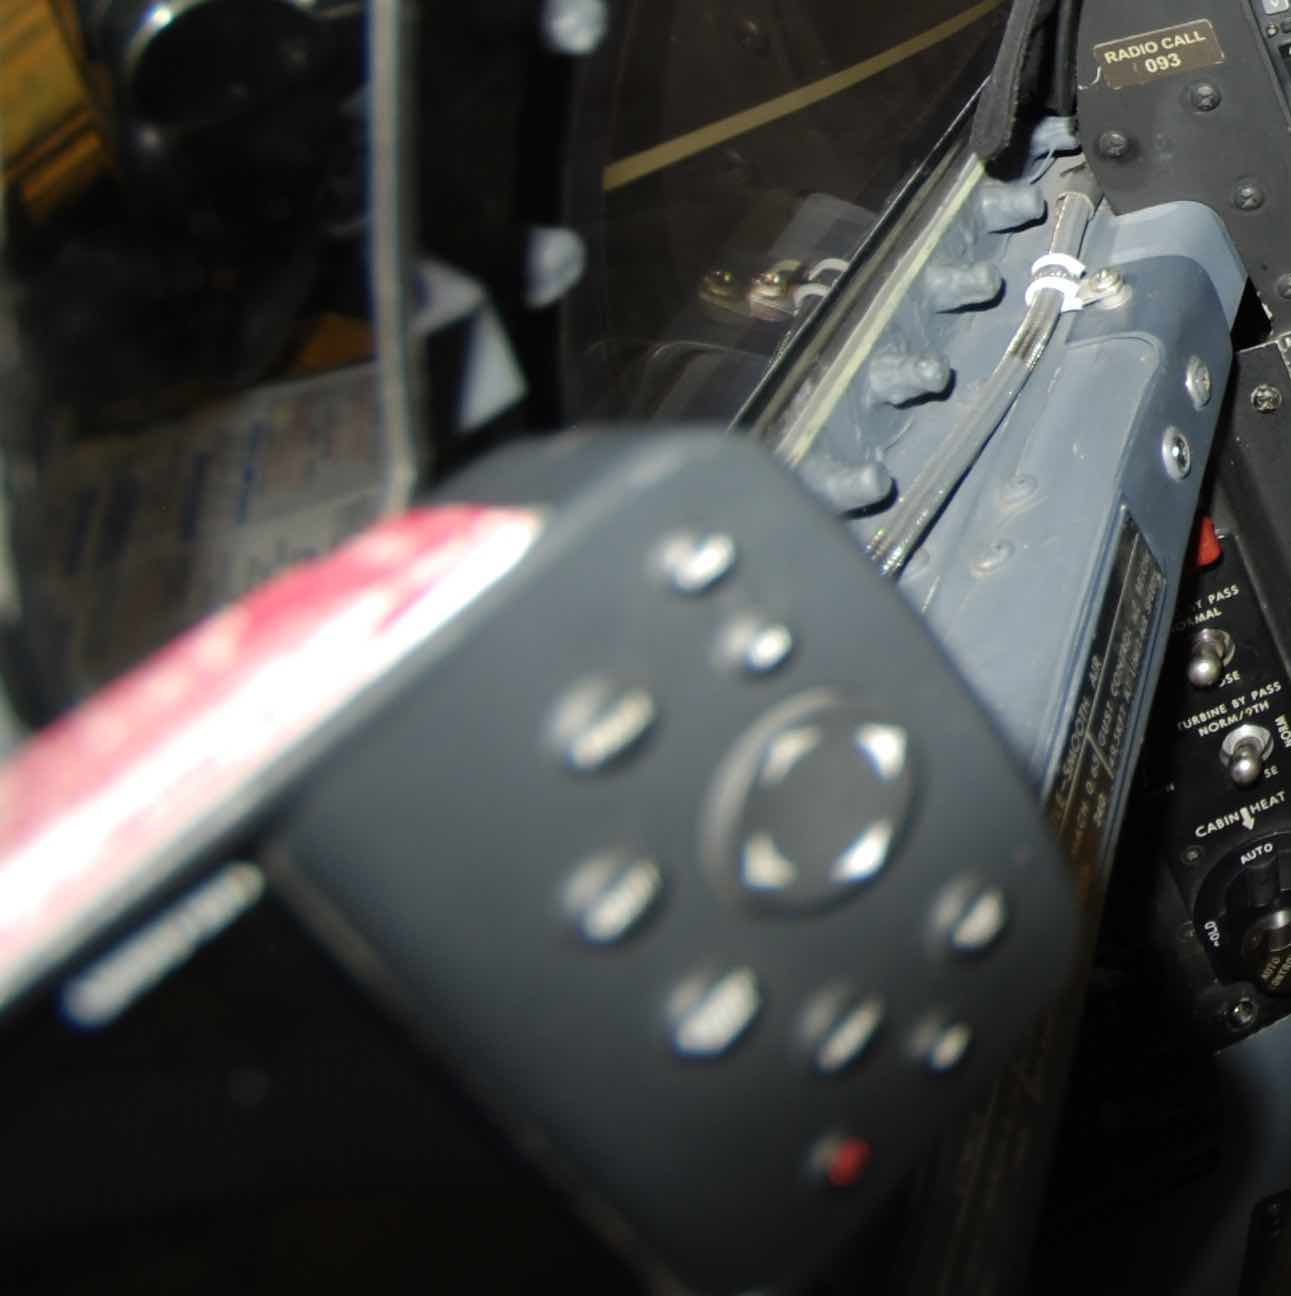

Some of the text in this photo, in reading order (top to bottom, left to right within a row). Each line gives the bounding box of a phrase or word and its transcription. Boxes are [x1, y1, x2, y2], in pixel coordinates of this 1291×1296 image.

[1103, 30, 1206, 64] RADIO CALL
[1144, 54, 1182, 75] 093
[1207, 584, 1240, 606] PASS
[1231, 695, 1248, 710] BY
[1250, 680, 1282, 703] PASS
[1194, 790, 1288, 838] CABIN HEAT
[1239, 841, 1274, 866] AUTO
